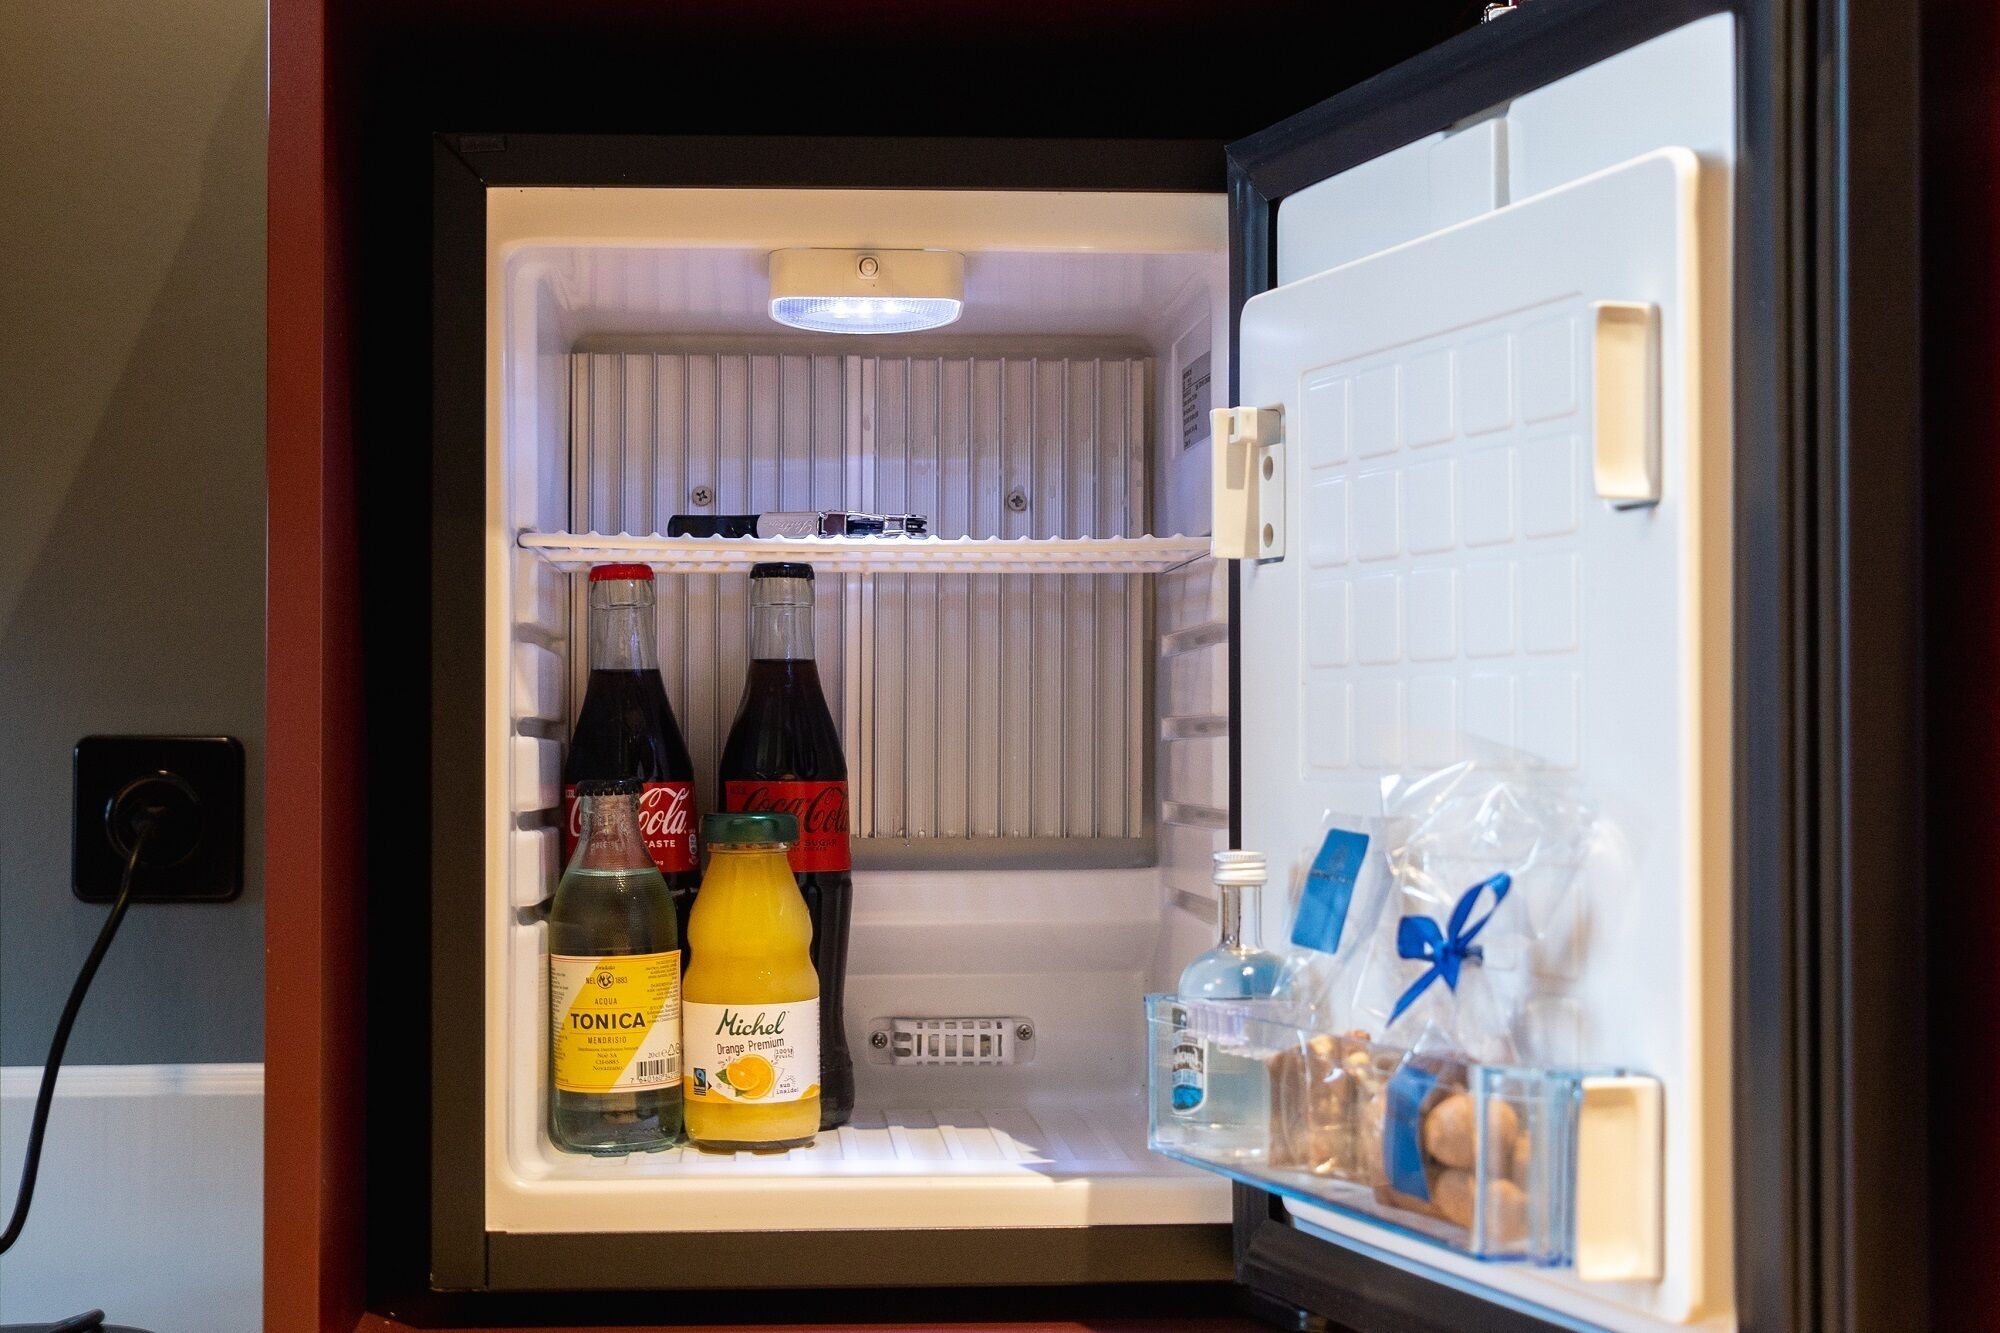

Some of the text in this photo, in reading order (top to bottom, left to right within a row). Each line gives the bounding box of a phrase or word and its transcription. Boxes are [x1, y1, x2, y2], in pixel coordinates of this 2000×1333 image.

[804, 838, 838, 848] SUGAR
[594, 997, 618, 1005] ACQUA
[570, 1012, 646, 1030] TONICA
[715, 1008, 787, 1036] Michel
[587, 1036, 627, 1044] MENDRISIO
[716, 1037, 785, 1057] Orange Premium
